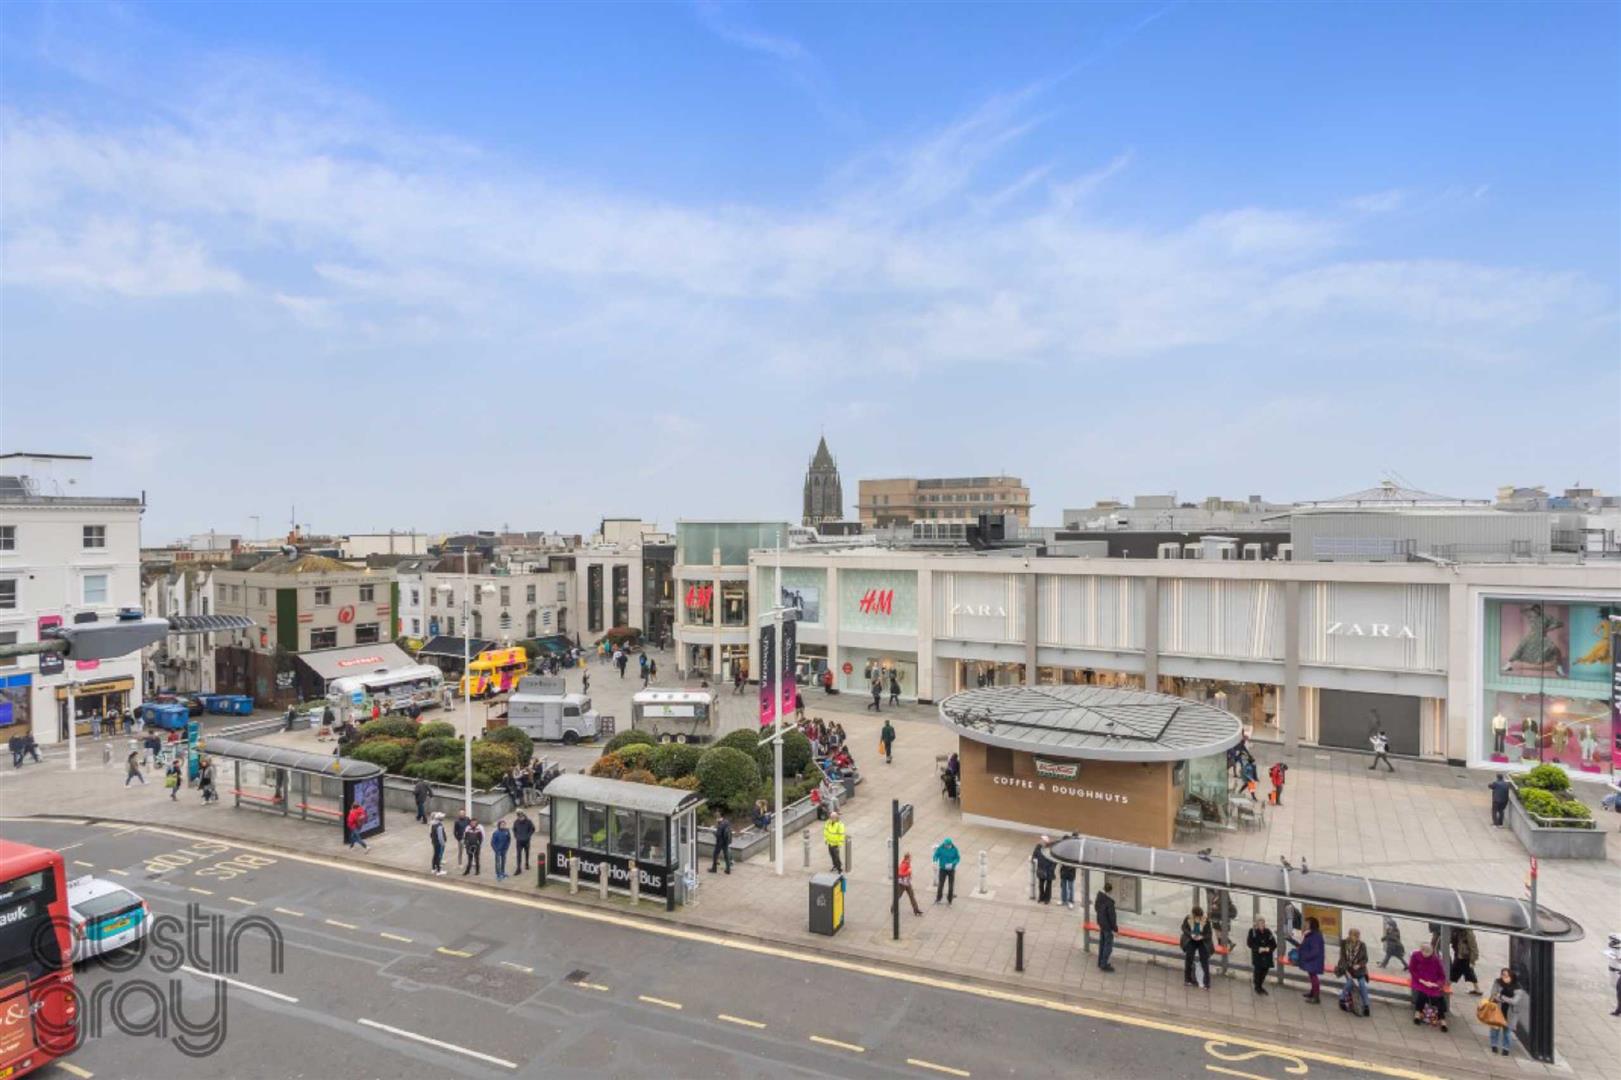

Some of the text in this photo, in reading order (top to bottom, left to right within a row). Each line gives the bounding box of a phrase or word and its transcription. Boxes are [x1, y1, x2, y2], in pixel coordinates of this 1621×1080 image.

[859, 588, 895, 616] H&M
[950, 603, 1007, 617] ZARA
[1326, 622, 1419, 639] ZARA
[993, 776, 1033, 789] COFFEE
[1052, 785, 1129, 804] DOUGHNUTS
[143, 841, 230, 873] STOP
[195, 854, 277, 881] BUS
[608, 863, 632, 881] Hov
[639, 870, 662, 888] Bus
